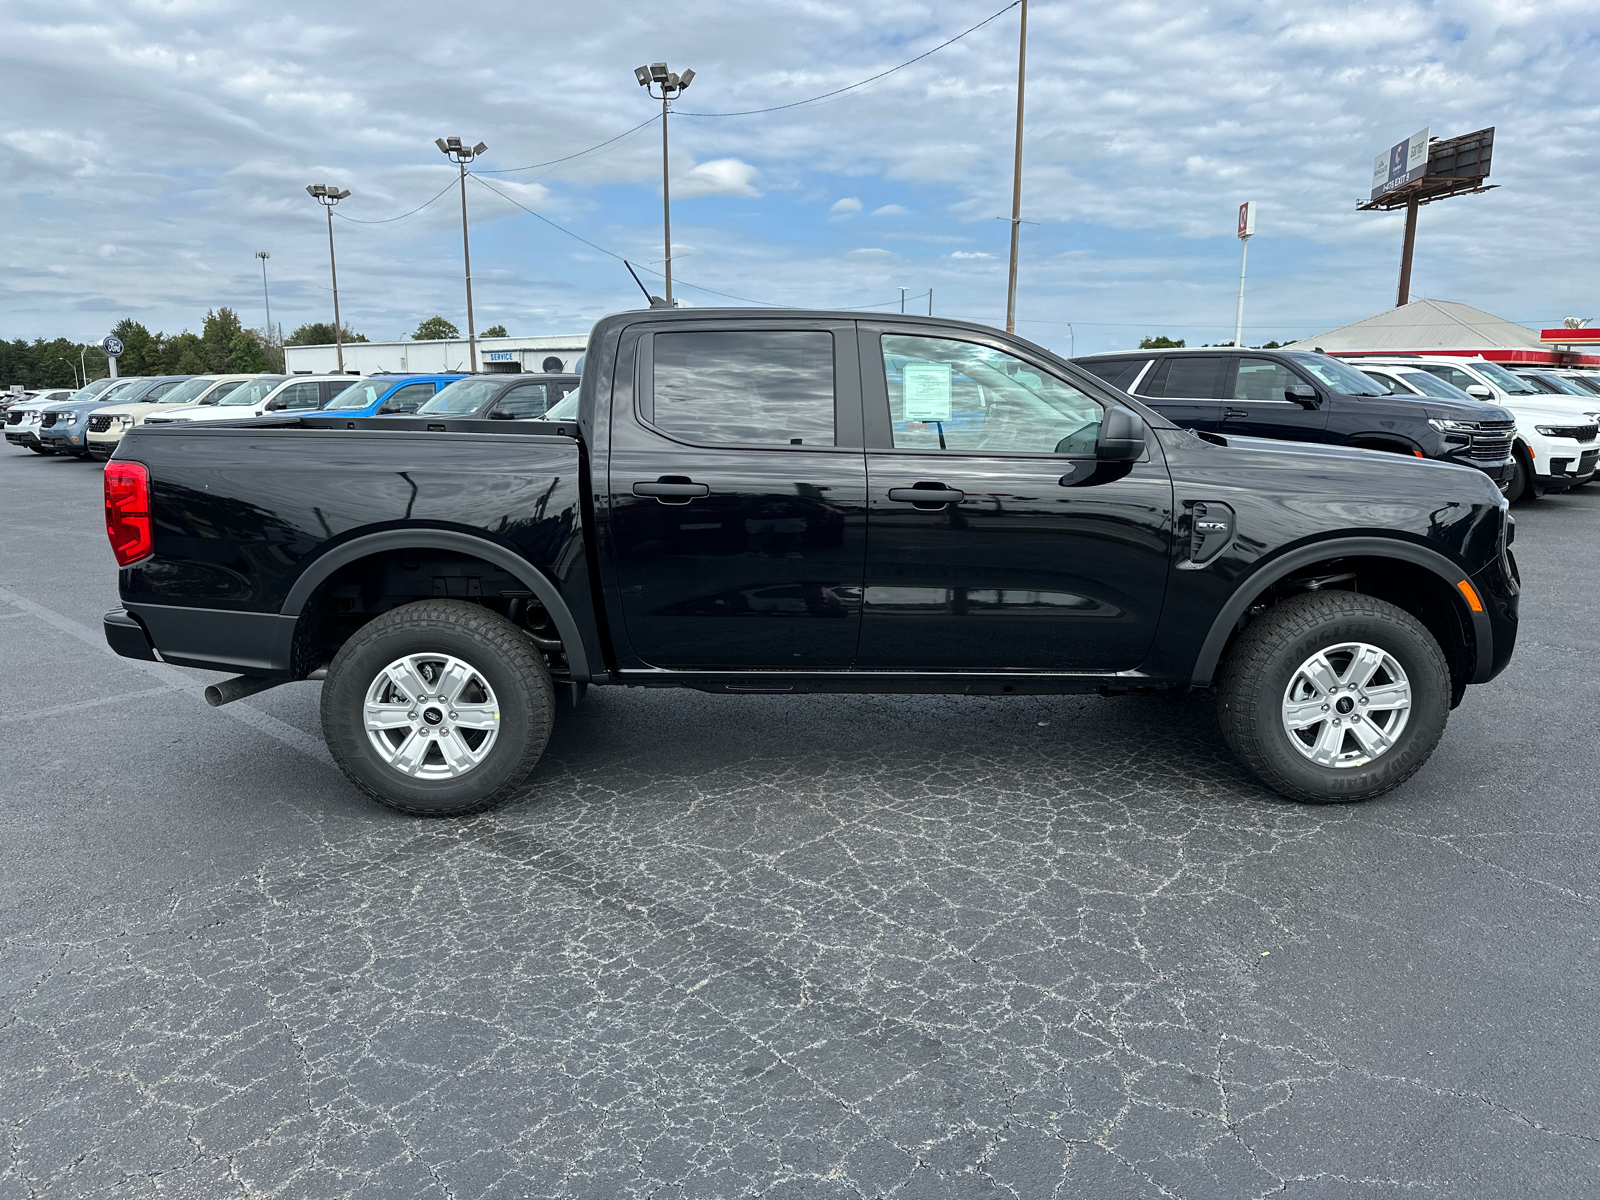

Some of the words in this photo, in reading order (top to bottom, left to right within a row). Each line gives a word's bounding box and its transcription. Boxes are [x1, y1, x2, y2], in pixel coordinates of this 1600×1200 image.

[1395, 174, 1406, 187] EXIT
[108, 339, 121, 352] Ford
[490, 352, 512, 361] SERVICE
[1274, 624, 1371, 682] WRANGLER
[339, 645, 385, 757] WRANGLER
[1330, 730, 1428, 790] GOODYEAR
